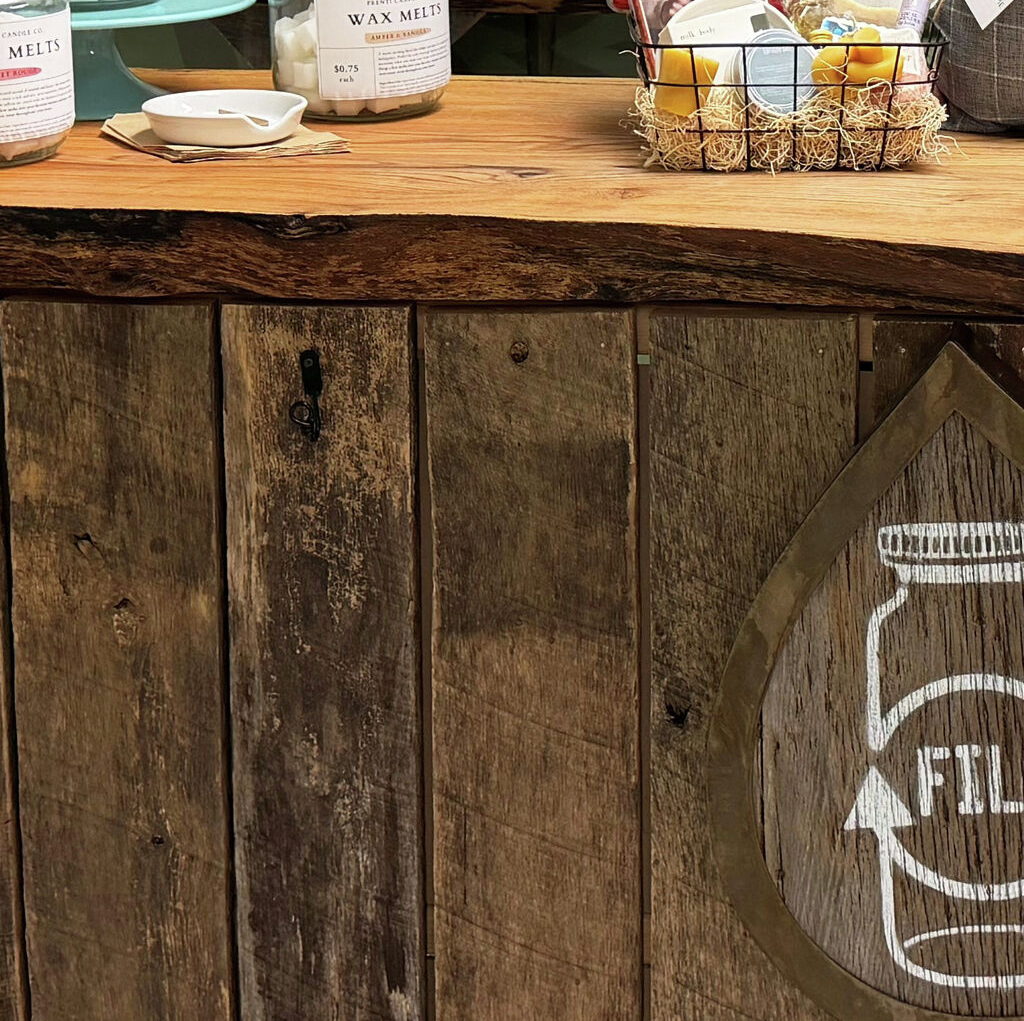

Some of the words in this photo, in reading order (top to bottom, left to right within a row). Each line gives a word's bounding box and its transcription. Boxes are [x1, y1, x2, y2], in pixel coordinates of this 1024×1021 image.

[347, 11, 393, 26] WAX
[400, 3, 442, 23] MELTS
[8, 39, 61, 60] MELTS
[333, 64, 359, 73] $0.75
